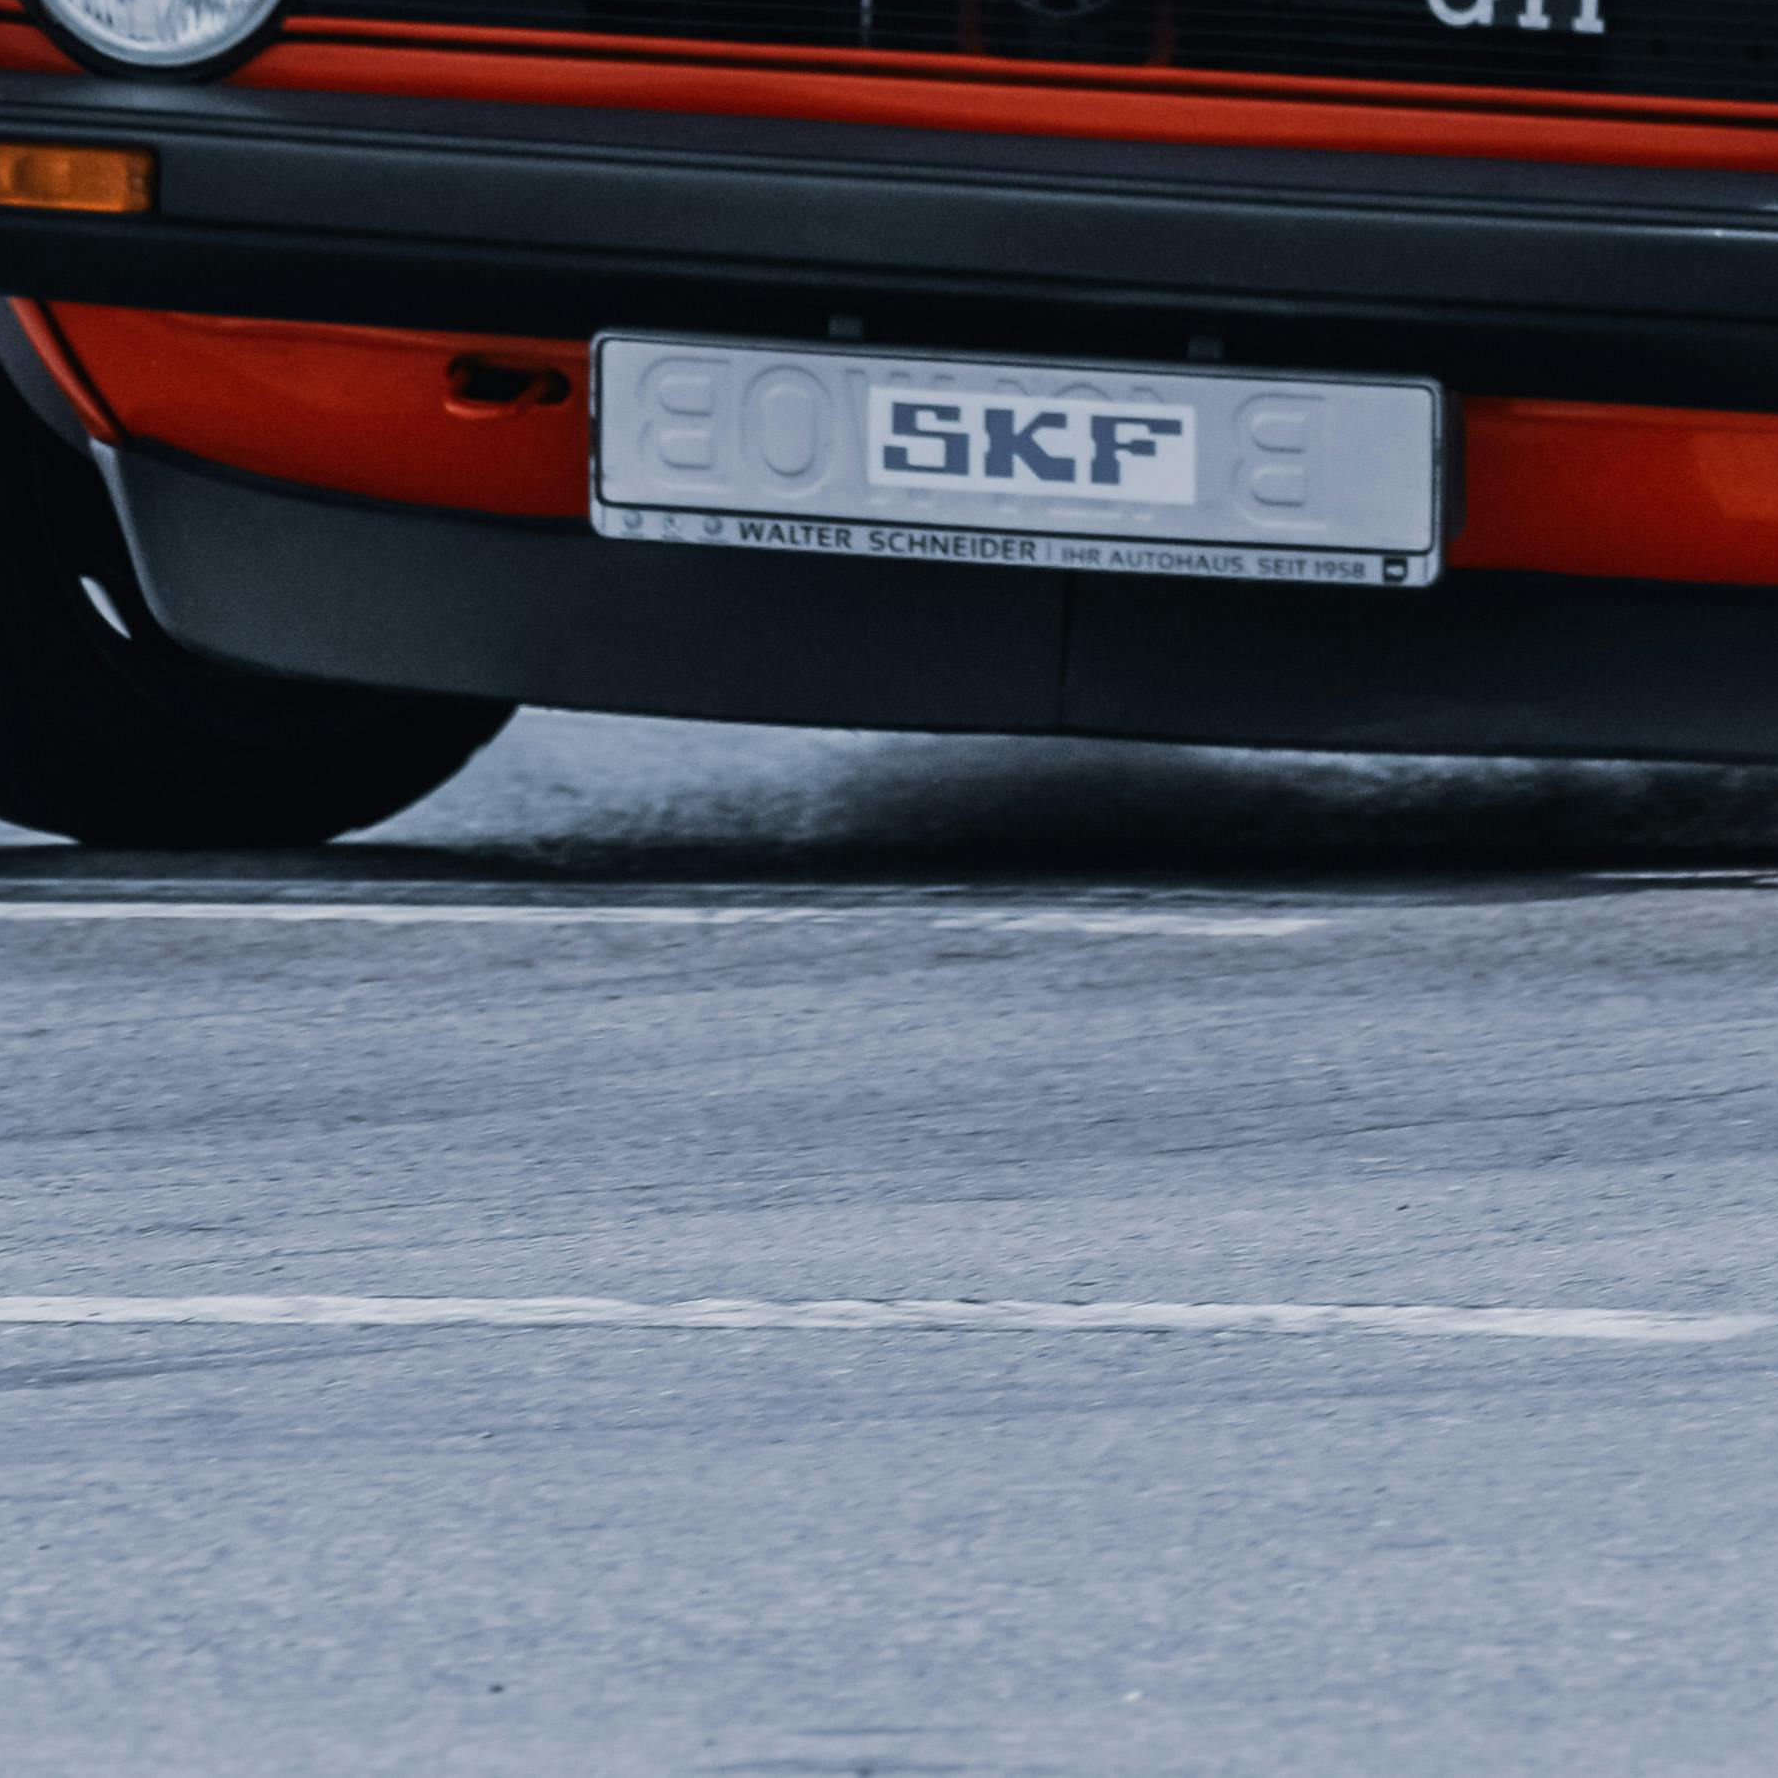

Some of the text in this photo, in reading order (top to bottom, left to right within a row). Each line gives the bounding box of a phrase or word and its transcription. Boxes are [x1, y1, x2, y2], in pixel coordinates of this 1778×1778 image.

[883, 401, 1182, 485] SKF
[739, 521, 852, 550] WALTER
[868, 530, 1037, 561] SCHNEIDER
[1060, 547, 1101, 565] IHR
[1108, 549, 1244, 573] AUTOHAUS
[1257, 556, 1308, 576] SEIT
[1315, 560, 1367, 579] 1958
